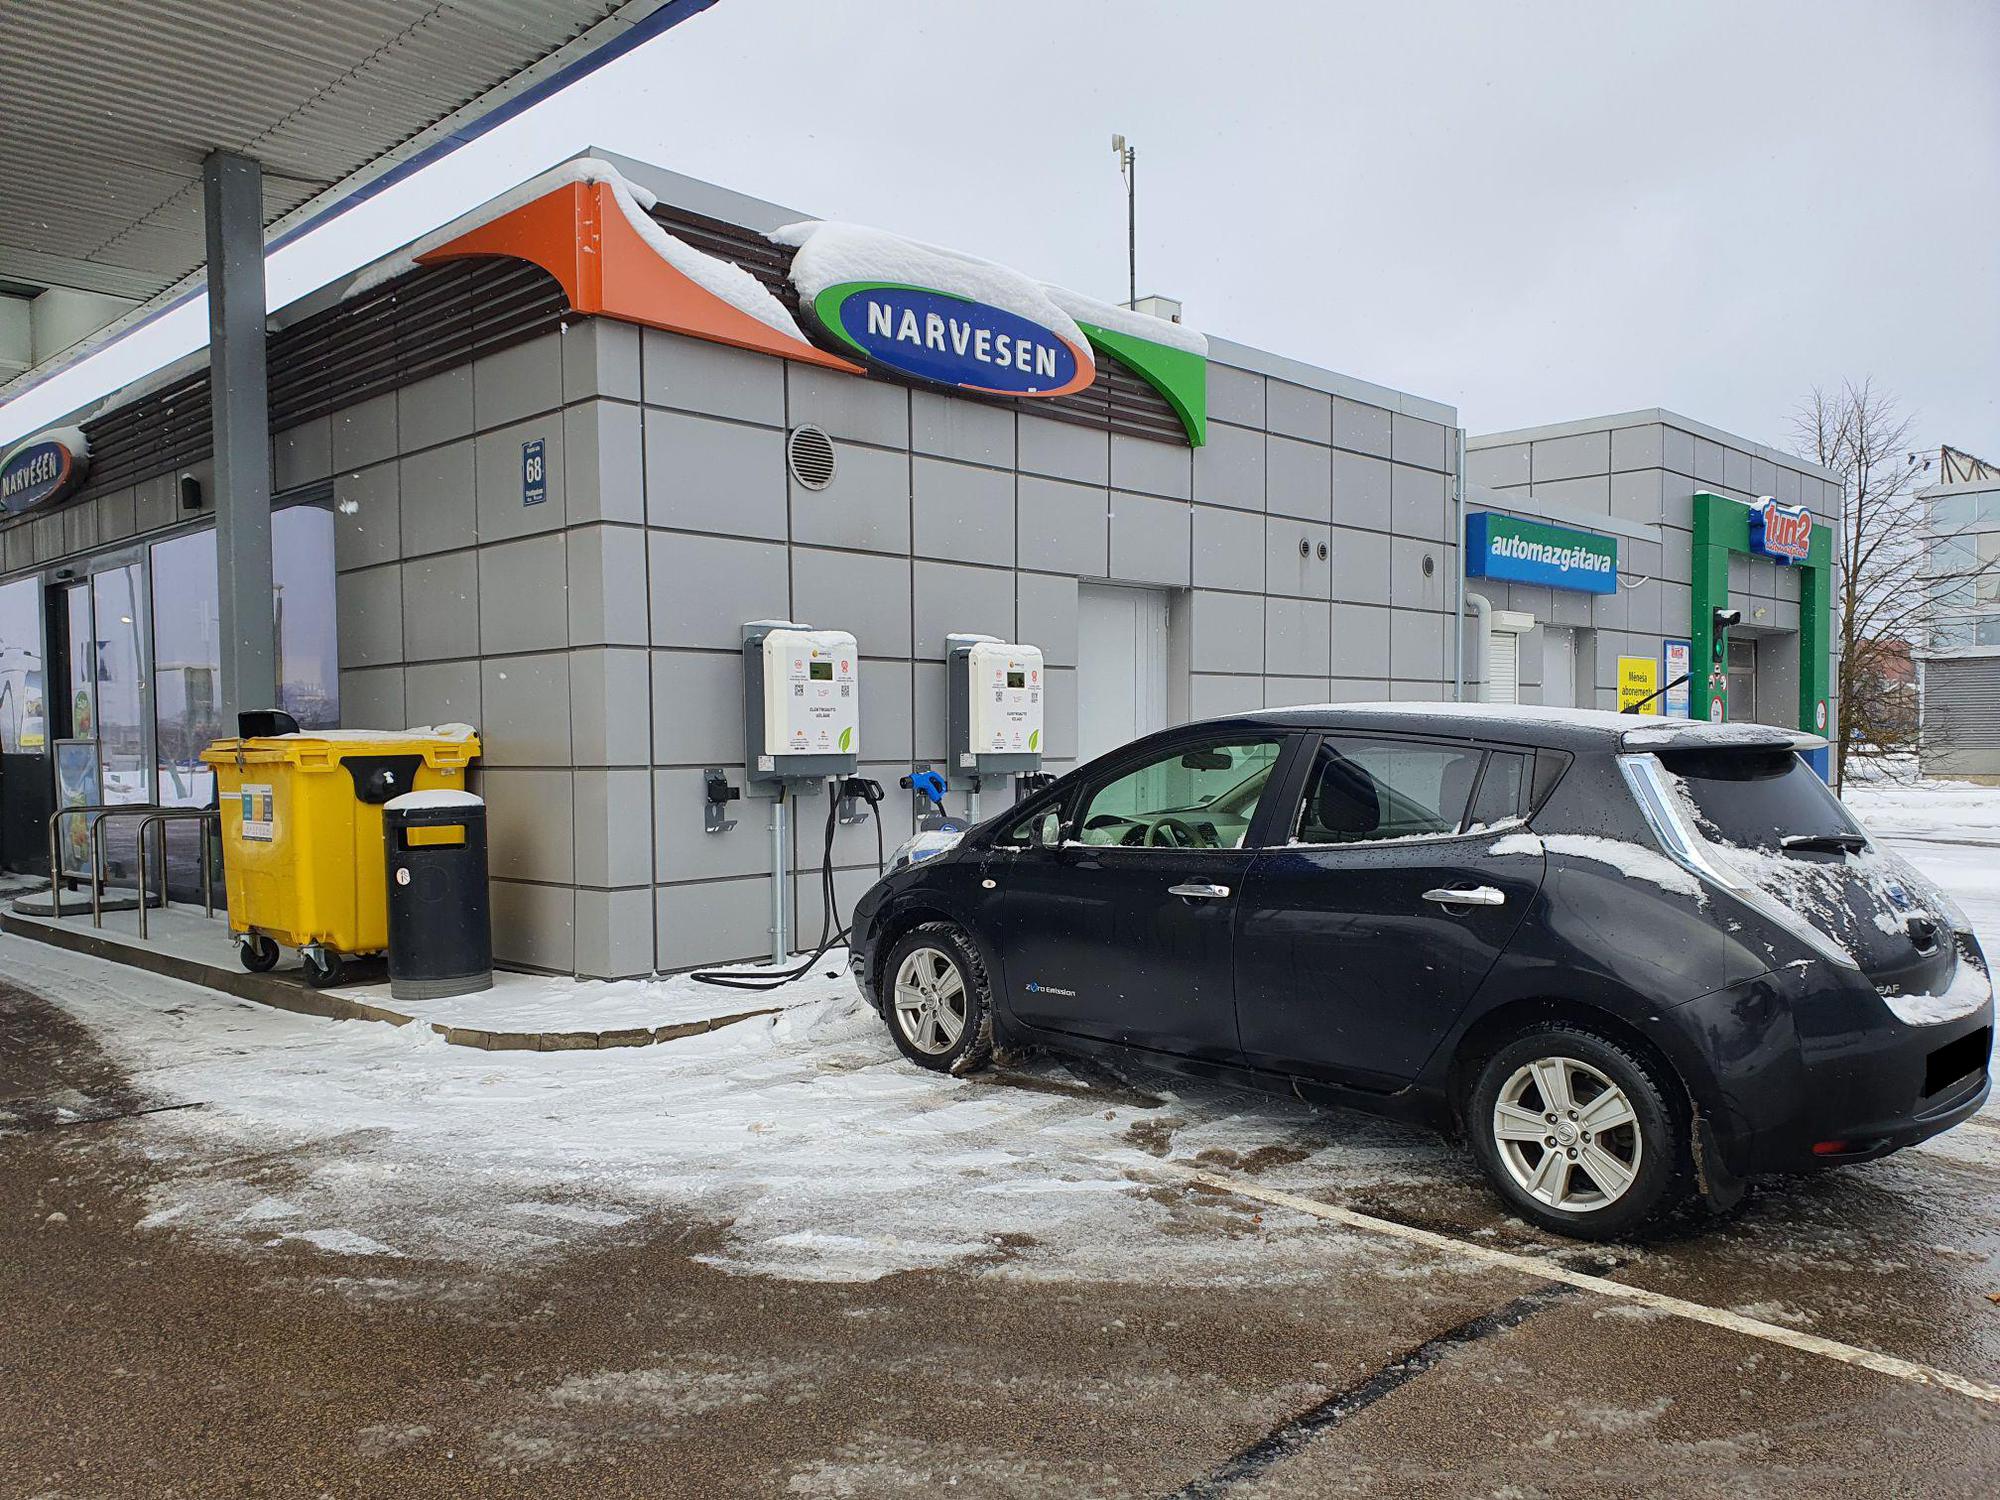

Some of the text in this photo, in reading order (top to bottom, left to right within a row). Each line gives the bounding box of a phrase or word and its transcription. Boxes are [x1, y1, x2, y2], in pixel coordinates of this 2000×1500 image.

[867, 301, 1056, 378] NARVESEN
[2, 452, 57, 497] NARVESEN
[526, 456, 542, 483] 68
[1491, 534, 1611, 573] automazgātava
[1875, 984, 1900, 995] EAF
